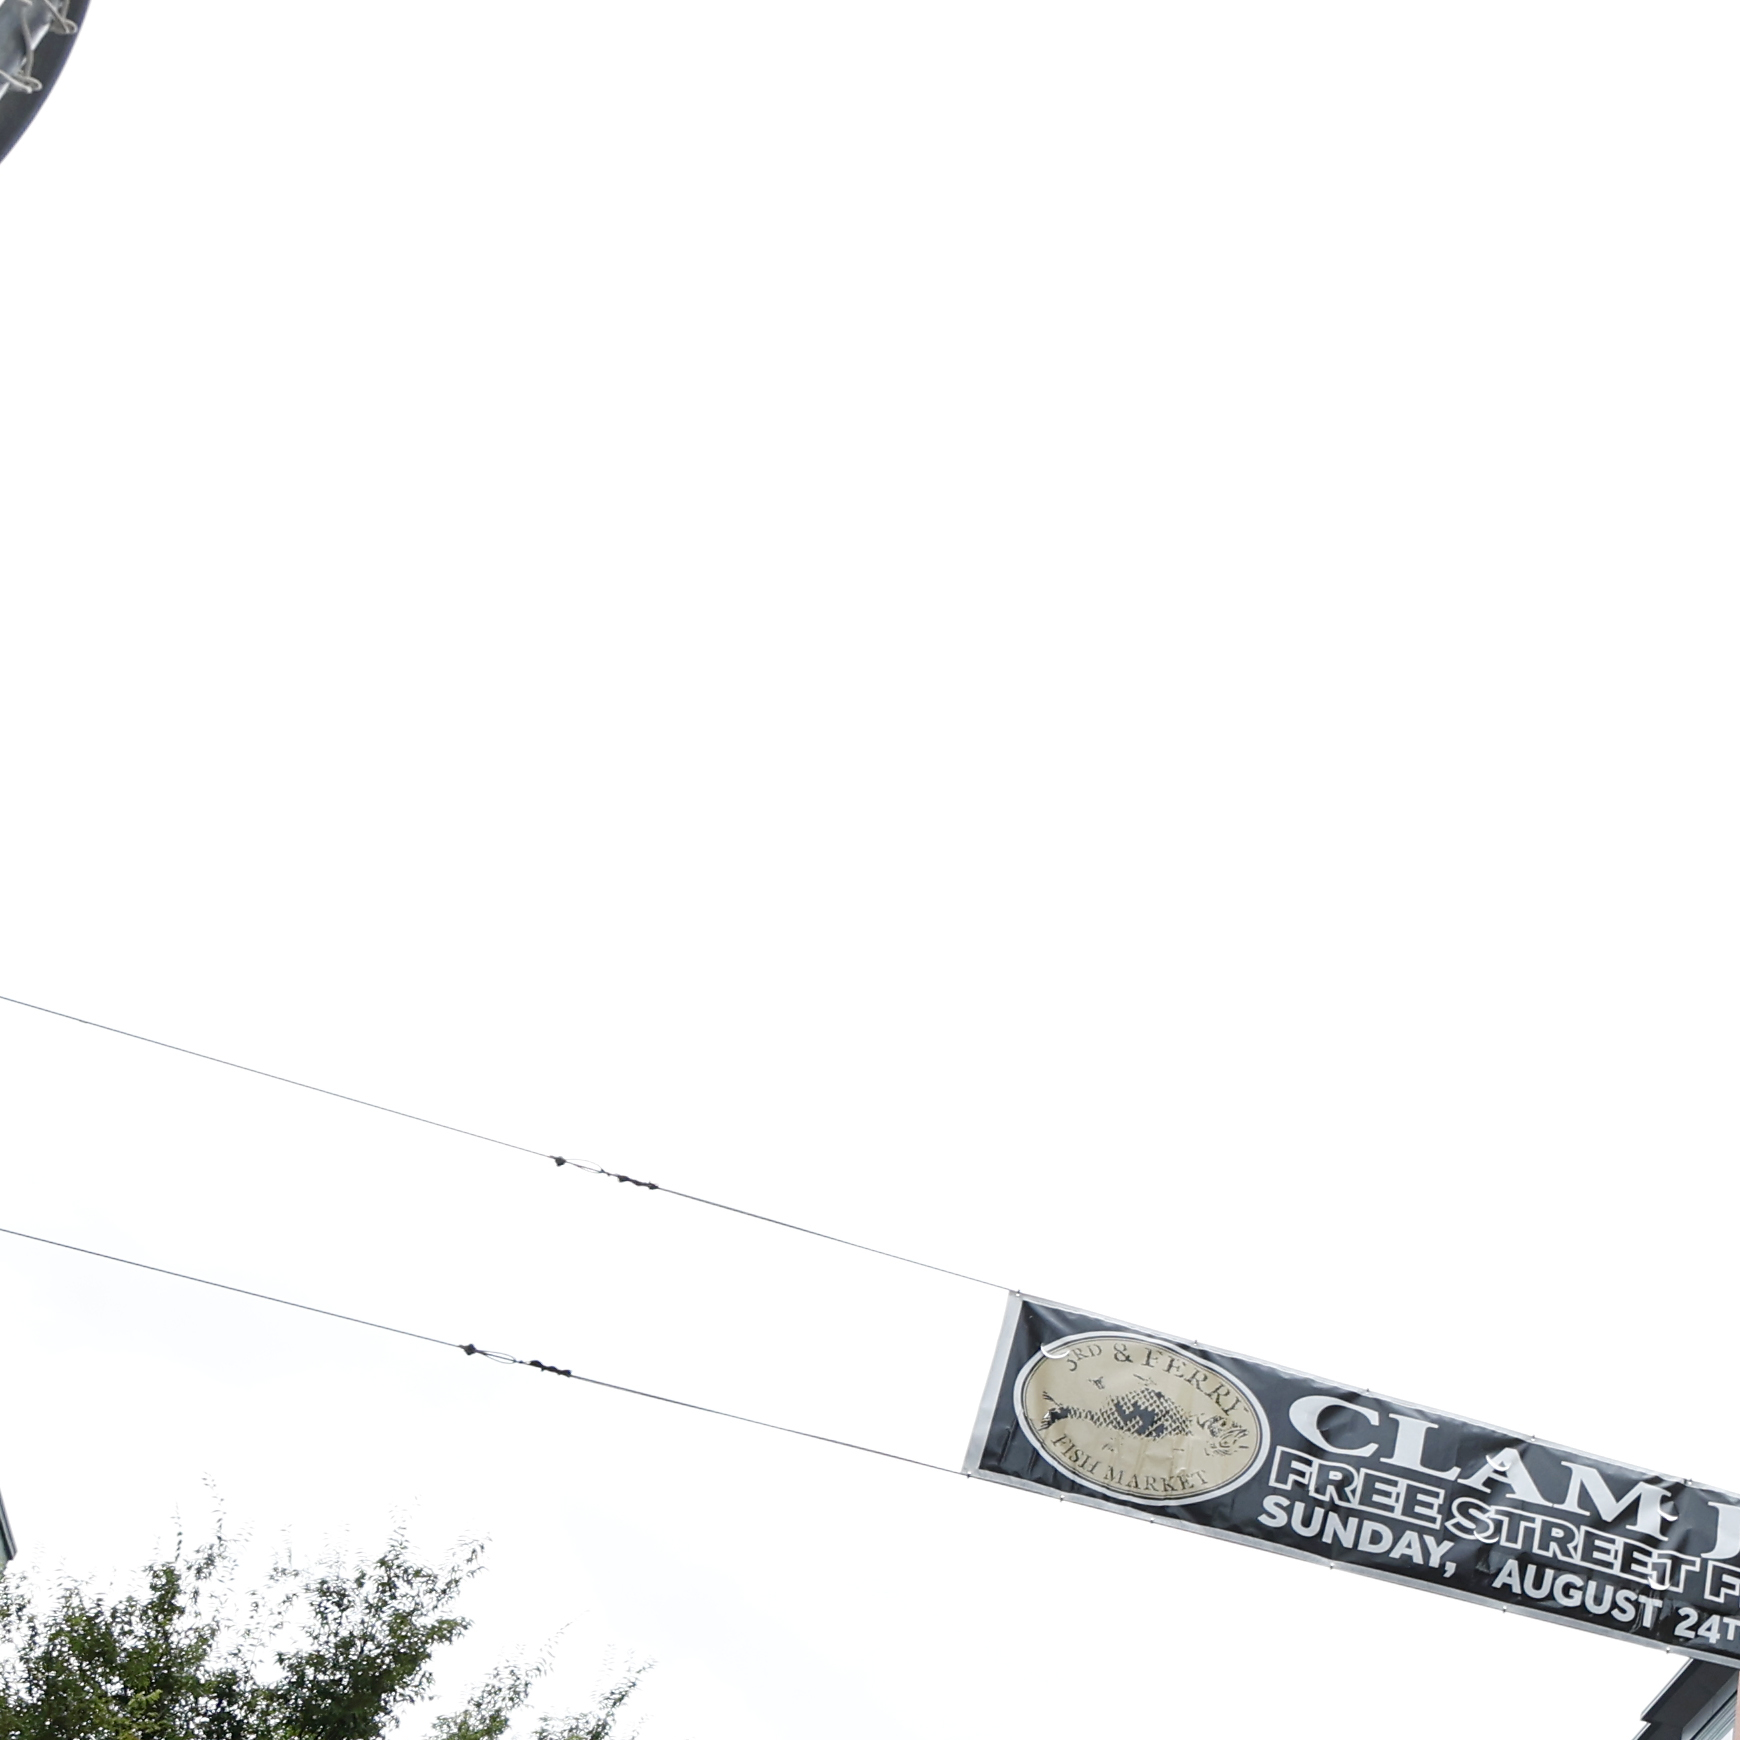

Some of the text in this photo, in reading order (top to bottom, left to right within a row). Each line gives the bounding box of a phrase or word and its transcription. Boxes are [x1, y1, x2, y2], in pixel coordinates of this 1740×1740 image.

[1113, 1342, 1133, 1364] &
[1141, 1346, 1250, 1416] FERRY
[1051, 1433, 1209, 1493] FISH MARKET
[1268, 1445, 1445, 1530] FREE
[1445, 1496, 1700, 1594] STREET
[1288, 1394, 1673, 1542] CLAM
[1257, 1494, 1457, 1578] SUNDAY,
[1492, 1558, 1663, 1629] AUGUST
